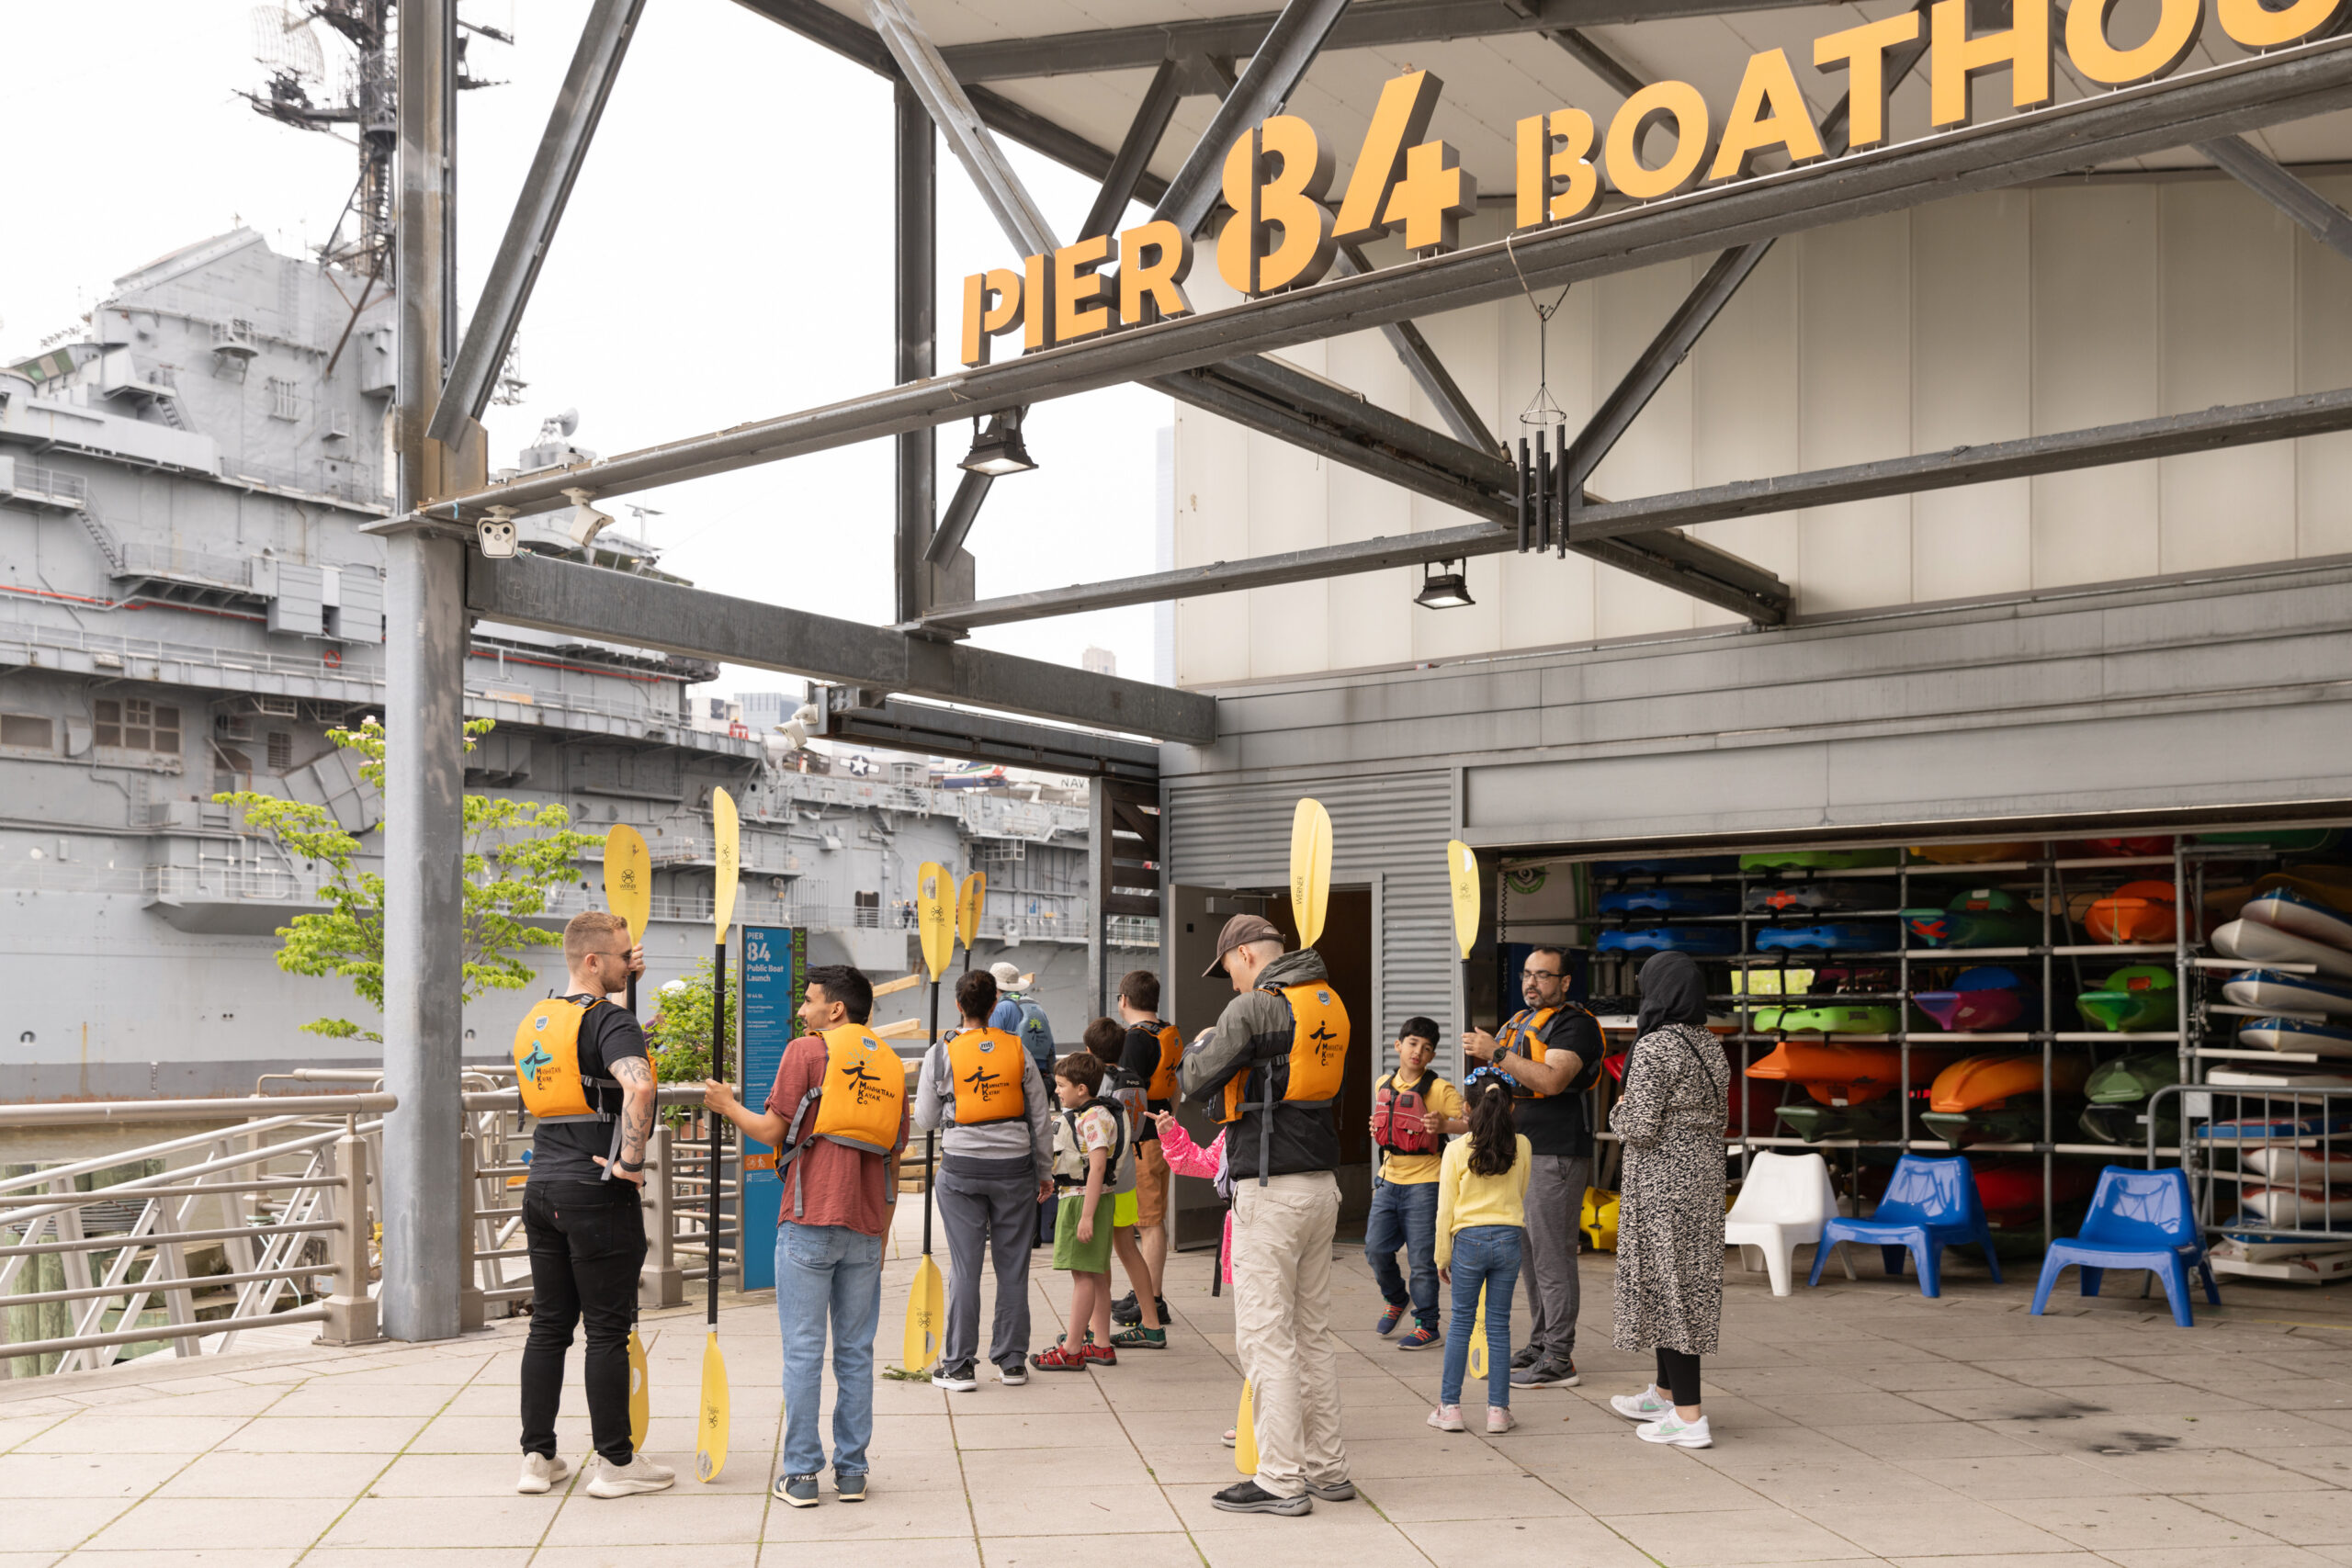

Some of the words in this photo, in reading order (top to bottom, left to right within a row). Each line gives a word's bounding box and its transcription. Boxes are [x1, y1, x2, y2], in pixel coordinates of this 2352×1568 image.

[961, 220, 1196, 367] PIER
[1216, 69, 1473, 297] 84
[1061, 778, 1086, 788] NAV
[747, 931, 763, 940] PIER
[795, 931, 805, 953] PK
[747, 942, 772, 962] 84
[747, 974, 771, 982] Launch
[795, 956, 805, 1002] RIVER
